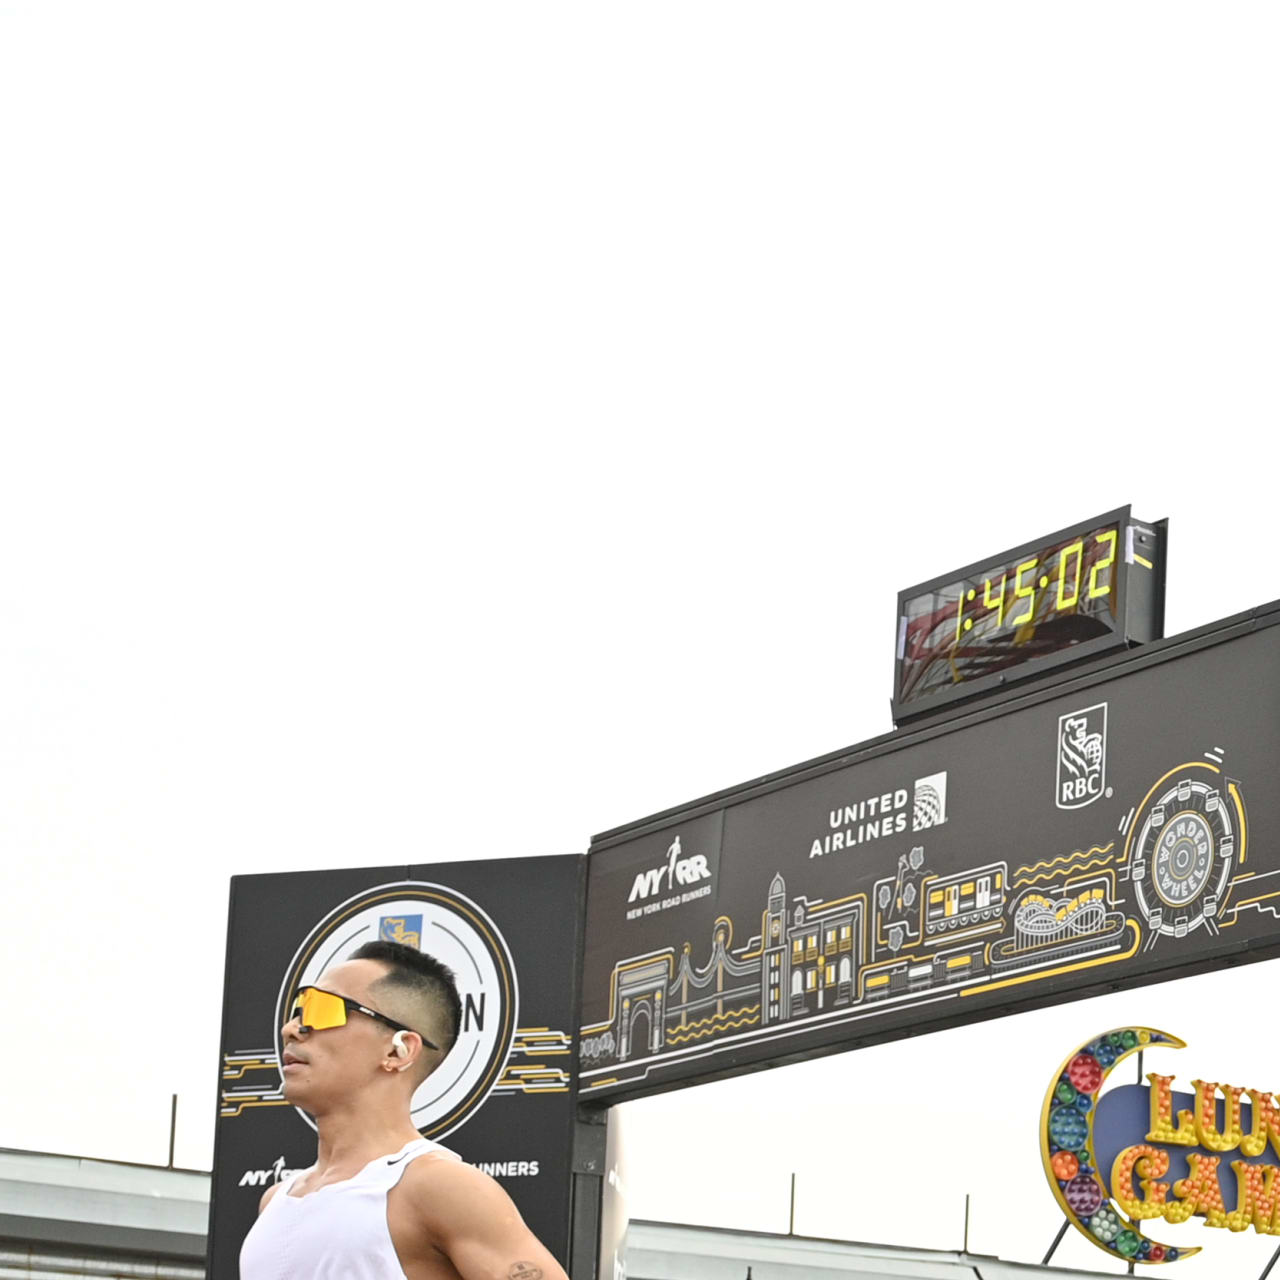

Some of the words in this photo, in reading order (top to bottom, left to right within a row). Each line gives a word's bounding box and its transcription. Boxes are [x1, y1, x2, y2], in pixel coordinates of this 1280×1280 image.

[1062, 773, 1099, 802] RBC
[829, 789, 908, 829] UNITED
[809, 812, 907, 858] AIRLINES
[1159, 819, 1208, 863] WONDER
[627, 907, 642, 920] NEW
[643, 902, 661, 916] YORK
[682, 885, 711, 904] RUNNERS
[1160, 870, 1205, 899] WHEEL
